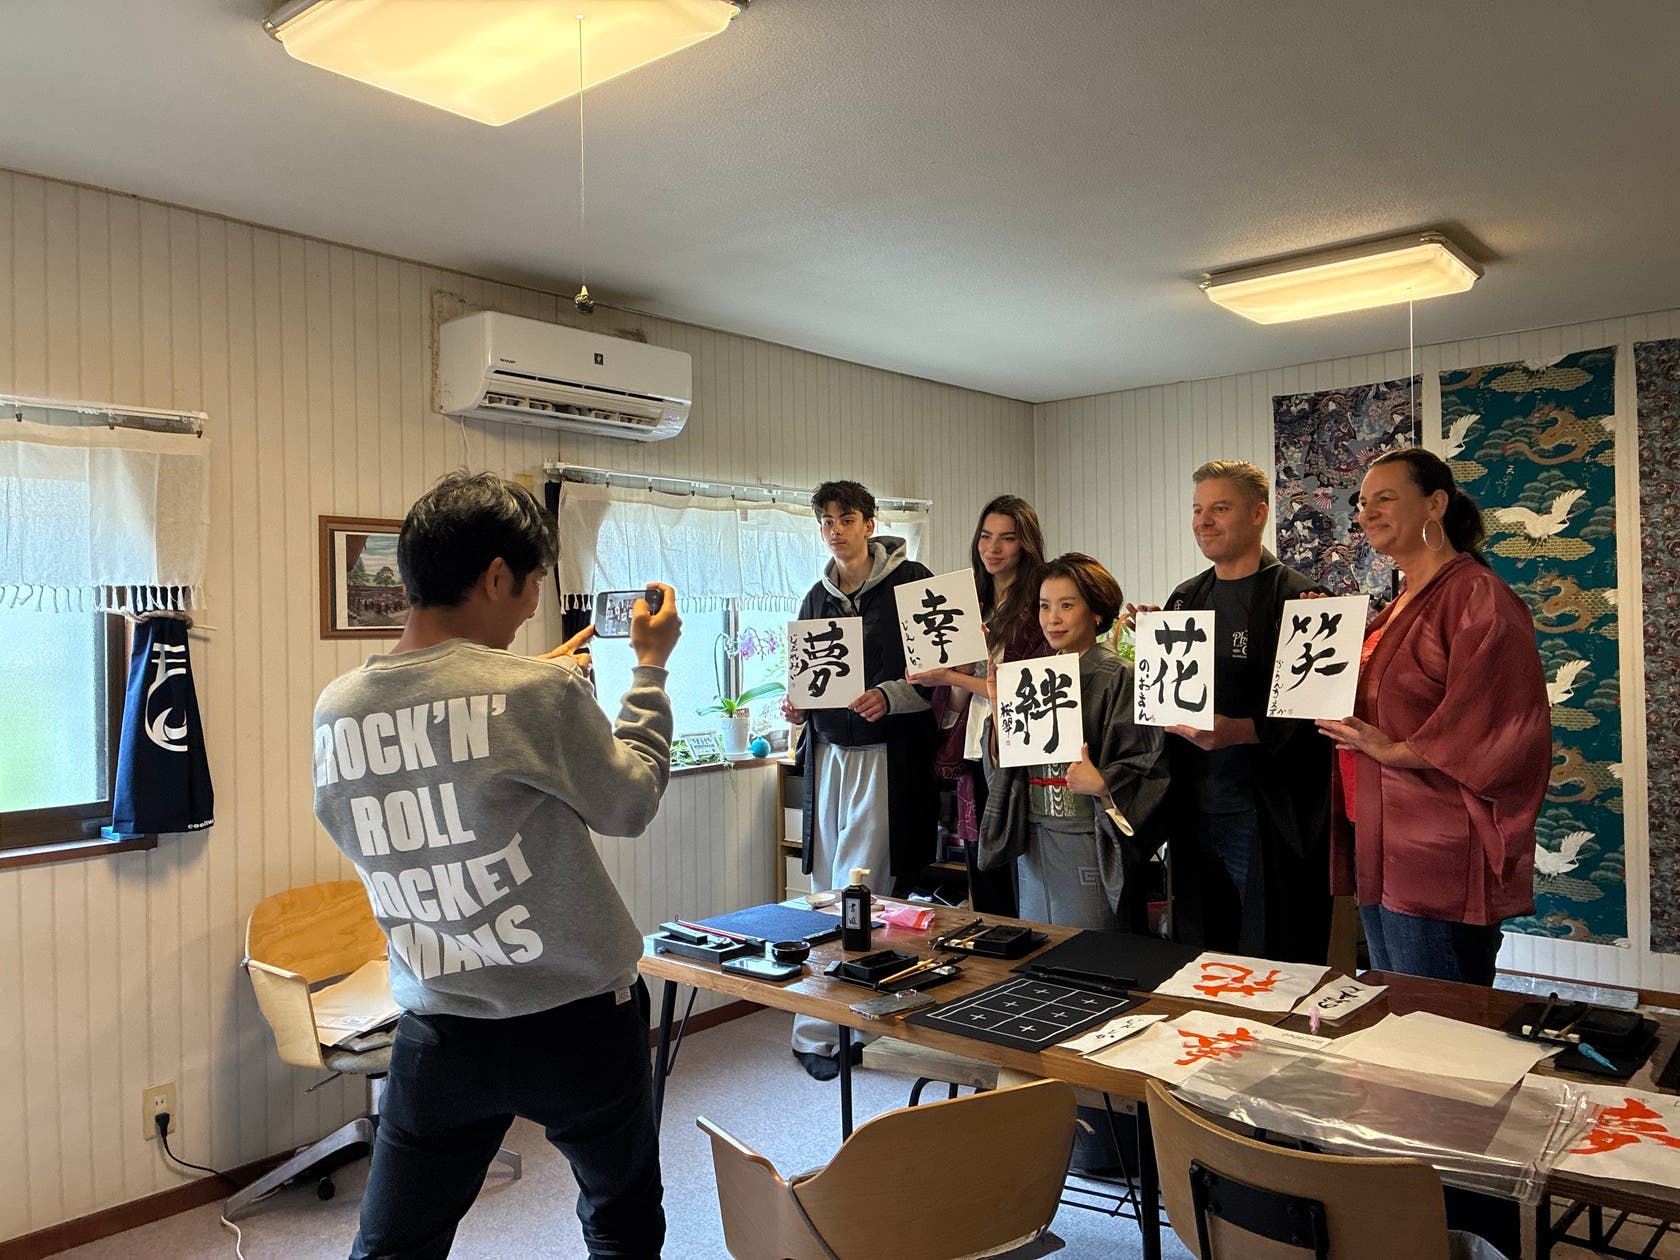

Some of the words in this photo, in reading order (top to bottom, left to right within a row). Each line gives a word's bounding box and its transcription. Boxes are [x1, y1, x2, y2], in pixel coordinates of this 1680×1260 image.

[798, 620, 850, 698] 夢
[912, 587, 965, 664] 幸
[1151, 616, 1208, 713] 花
[1284, 611, 1350, 693] 笑
[314, 694, 507, 787] ROCK'N'
[1013, 667, 1079, 754] 絆
[350, 782, 476, 857] ROLL
[390, 904, 544, 980] MANS
